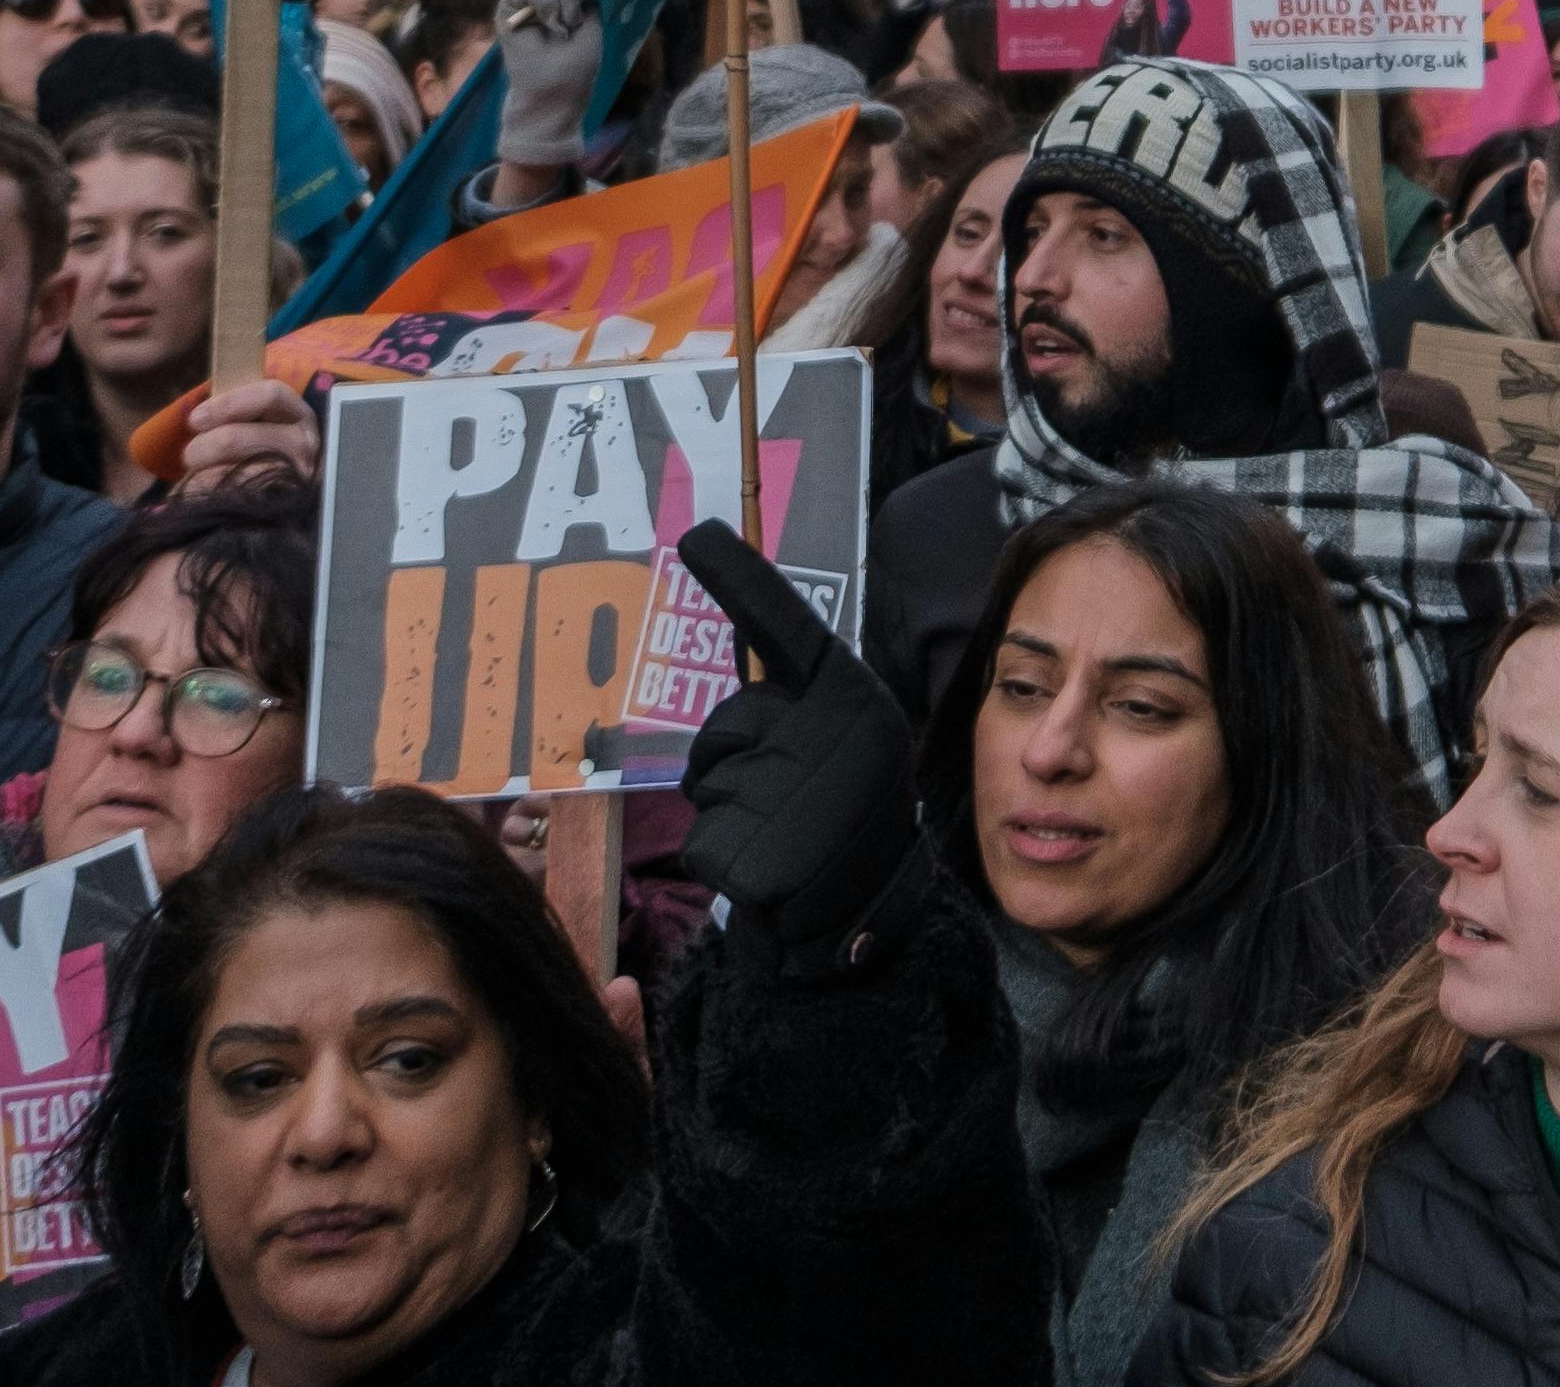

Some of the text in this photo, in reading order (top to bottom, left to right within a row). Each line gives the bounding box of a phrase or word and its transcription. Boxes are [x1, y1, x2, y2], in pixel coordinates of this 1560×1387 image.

[1388, 15, 1467, 35] PARTY
[1248, 51, 1468, 73] socialistparty.org.uk
[390, 360, 795, 563] PAY
